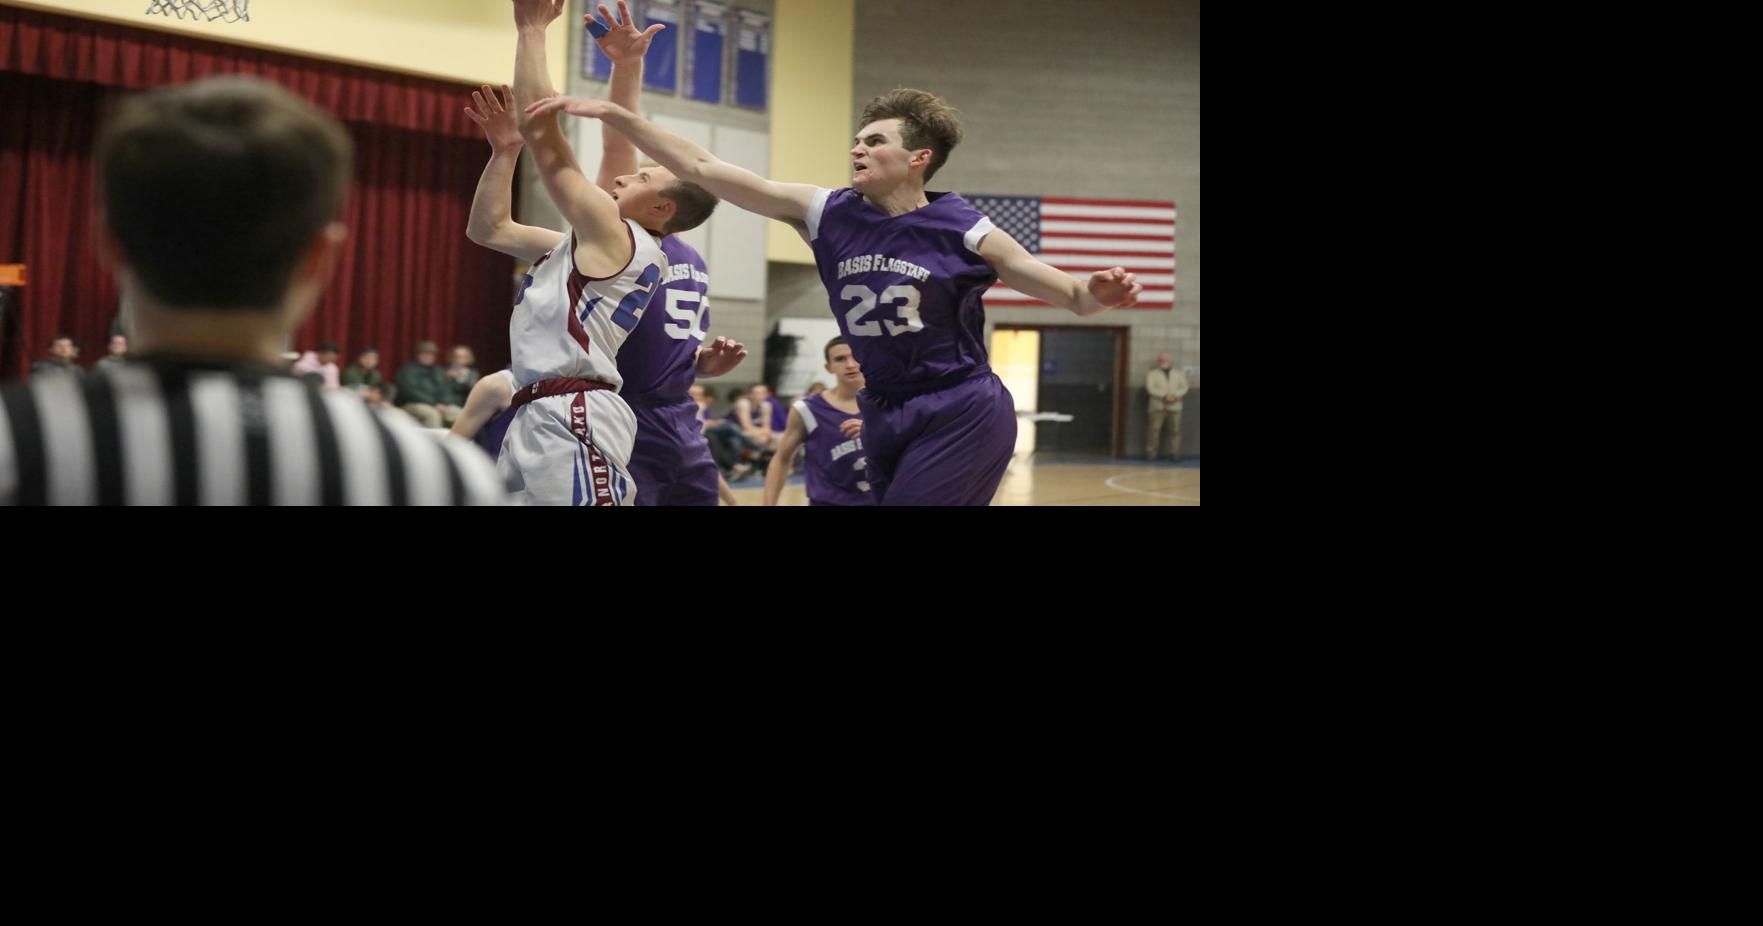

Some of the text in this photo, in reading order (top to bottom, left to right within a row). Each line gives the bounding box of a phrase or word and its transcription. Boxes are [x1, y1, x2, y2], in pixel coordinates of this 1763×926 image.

[661, 263, 690, 285] ASIS
[838, 254, 931, 282] BASIS FLAGSTAFF
[841, 284, 925, 337] 23
